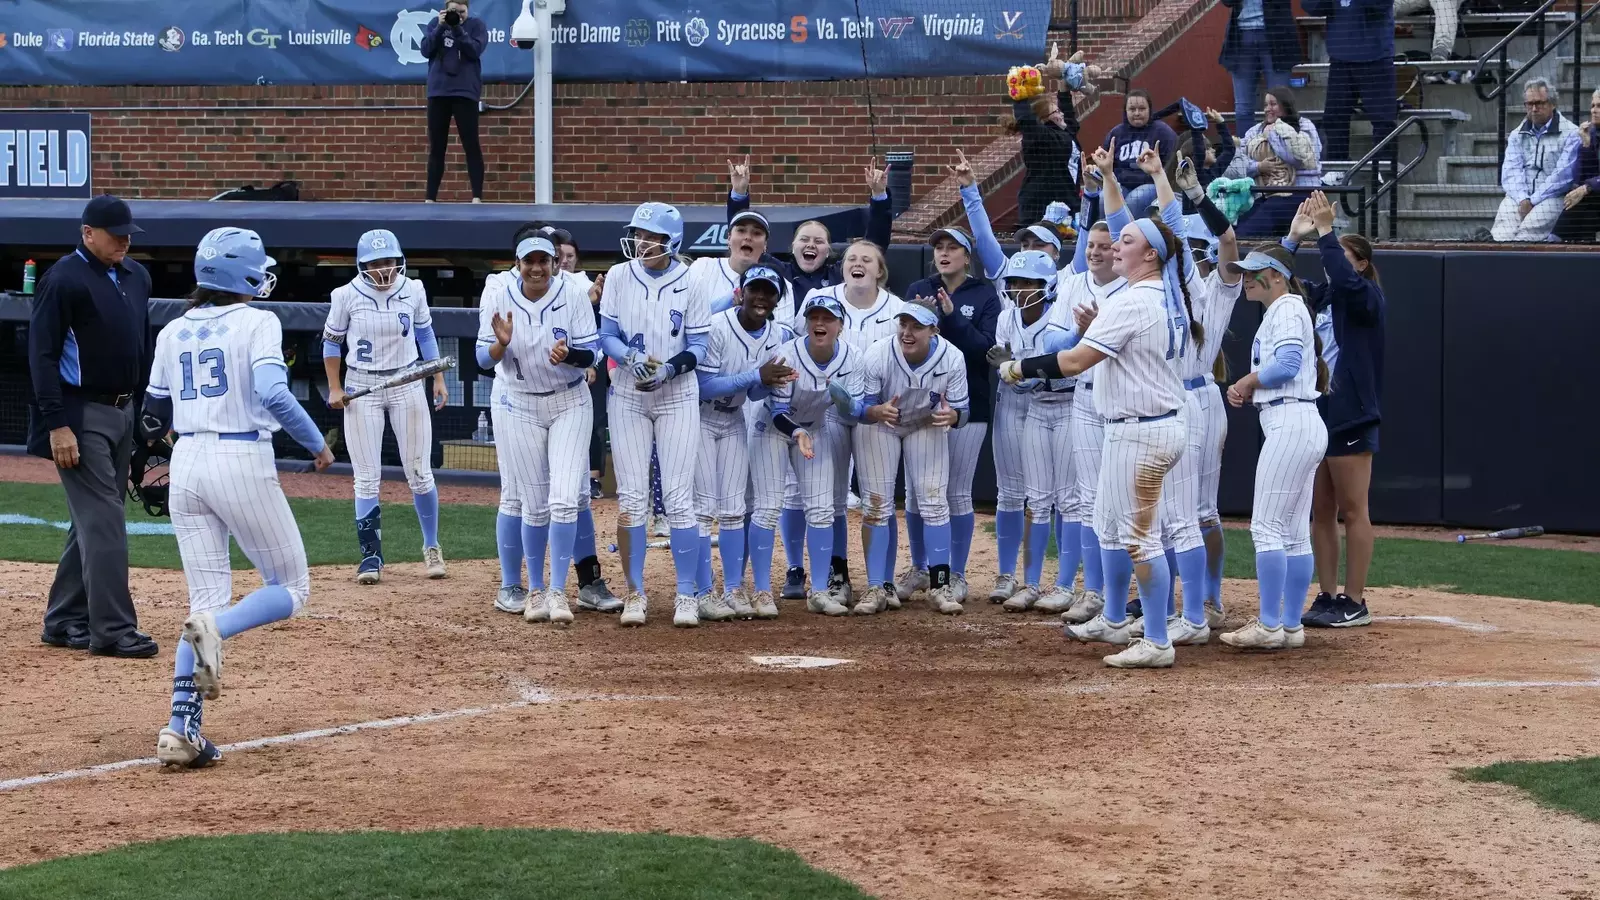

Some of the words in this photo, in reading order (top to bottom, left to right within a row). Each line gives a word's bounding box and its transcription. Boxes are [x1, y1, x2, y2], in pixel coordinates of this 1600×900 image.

[191, 30, 212, 46] Ga.
[214, 29, 243, 46] Tech
[288, 29, 352, 46] Louisville
[551, 24, 577, 44] otre
[580, 22, 621, 43] Dame
[656, 20, 681, 42] Pitt
[717, 19, 786, 46] Syracuse
[816, 18, 838, 40] Va.
[841, 16, 874, 39] Tech
[923, 13, 985, 41] Virginia
[13, 31, 43, 47] Duke
[78, 31, 121, 47] Florida
[122, 31, 155, 47] State
[0, 129, 88, 187] FIELD
[629, 333, 646, 354] 4
[1166, 316, 1188, 360] 17
[357, 339, 373, 363] 2
[179, 347, 228, 400] 13
[513, 357, 525, 381] 1
[175, 680, 195, 688] HEEL
